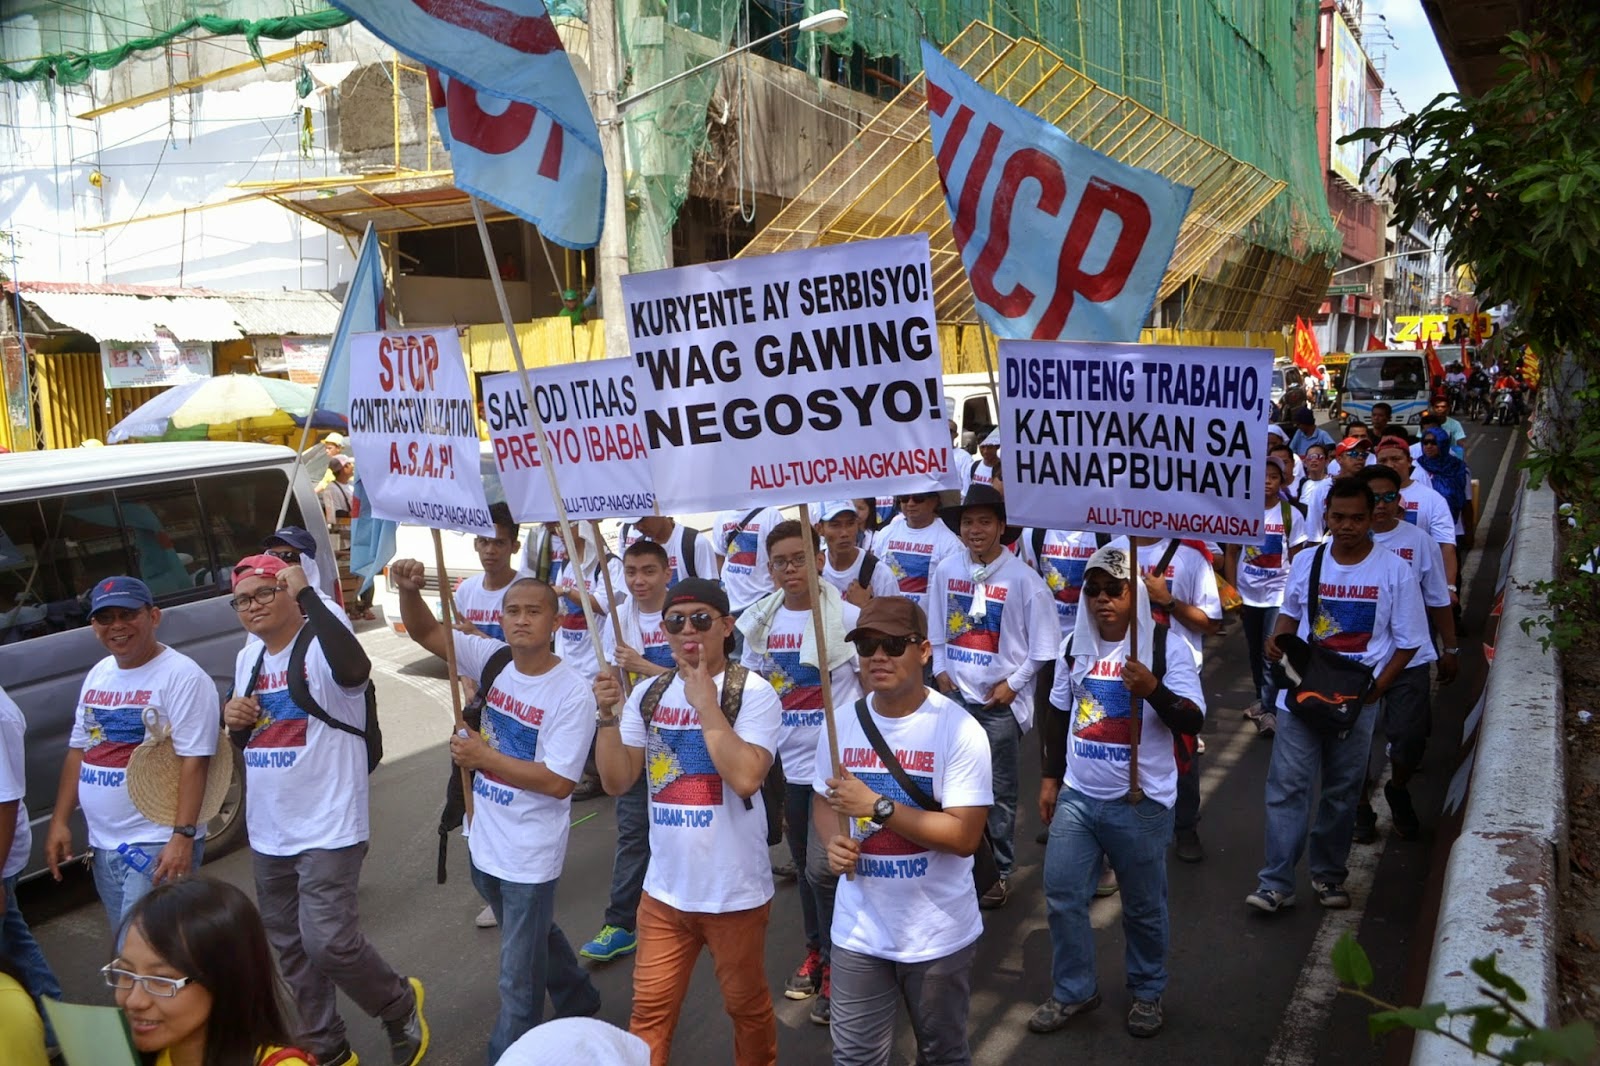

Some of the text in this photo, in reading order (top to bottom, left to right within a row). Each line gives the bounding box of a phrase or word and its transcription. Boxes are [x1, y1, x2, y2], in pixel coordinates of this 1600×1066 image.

[631, 262, 929, 338] KURYENTE AY SERBISYO!
[379, 334, 440, 393] STOP
[636, 316, 933, 391] 'WAG GAWING
[570, 375, 637, 420] ITAAS
[1006, 357, 1264, 421] DISENTENG TRABAHO,
[644, 377, 942, 450] NEGOSYO!
[1015, 408, 1252, 459] KATIYAKAN SA
[494, 423, 648, 472] PREYO IBABA
[750, 448, 948, 490] ALU-TUCP-NAGKAISA!
[1016, 450, 1251, 499] HANAPBUHAY!
[407, 500, 491, 529] ALU-TUCP-NAGKAISA!
[1086, 506, 1260, 537] ALU-TUCP-NAGKAISA!
[1337, 584, 1347, 598] SA
[1347, 585, 1378, 600] JOLLIBEE
[787, 633, 795, 649] SA
[1101, 661, 1111, 677] SA
[843, 747, 877, 768] KILUSAN
